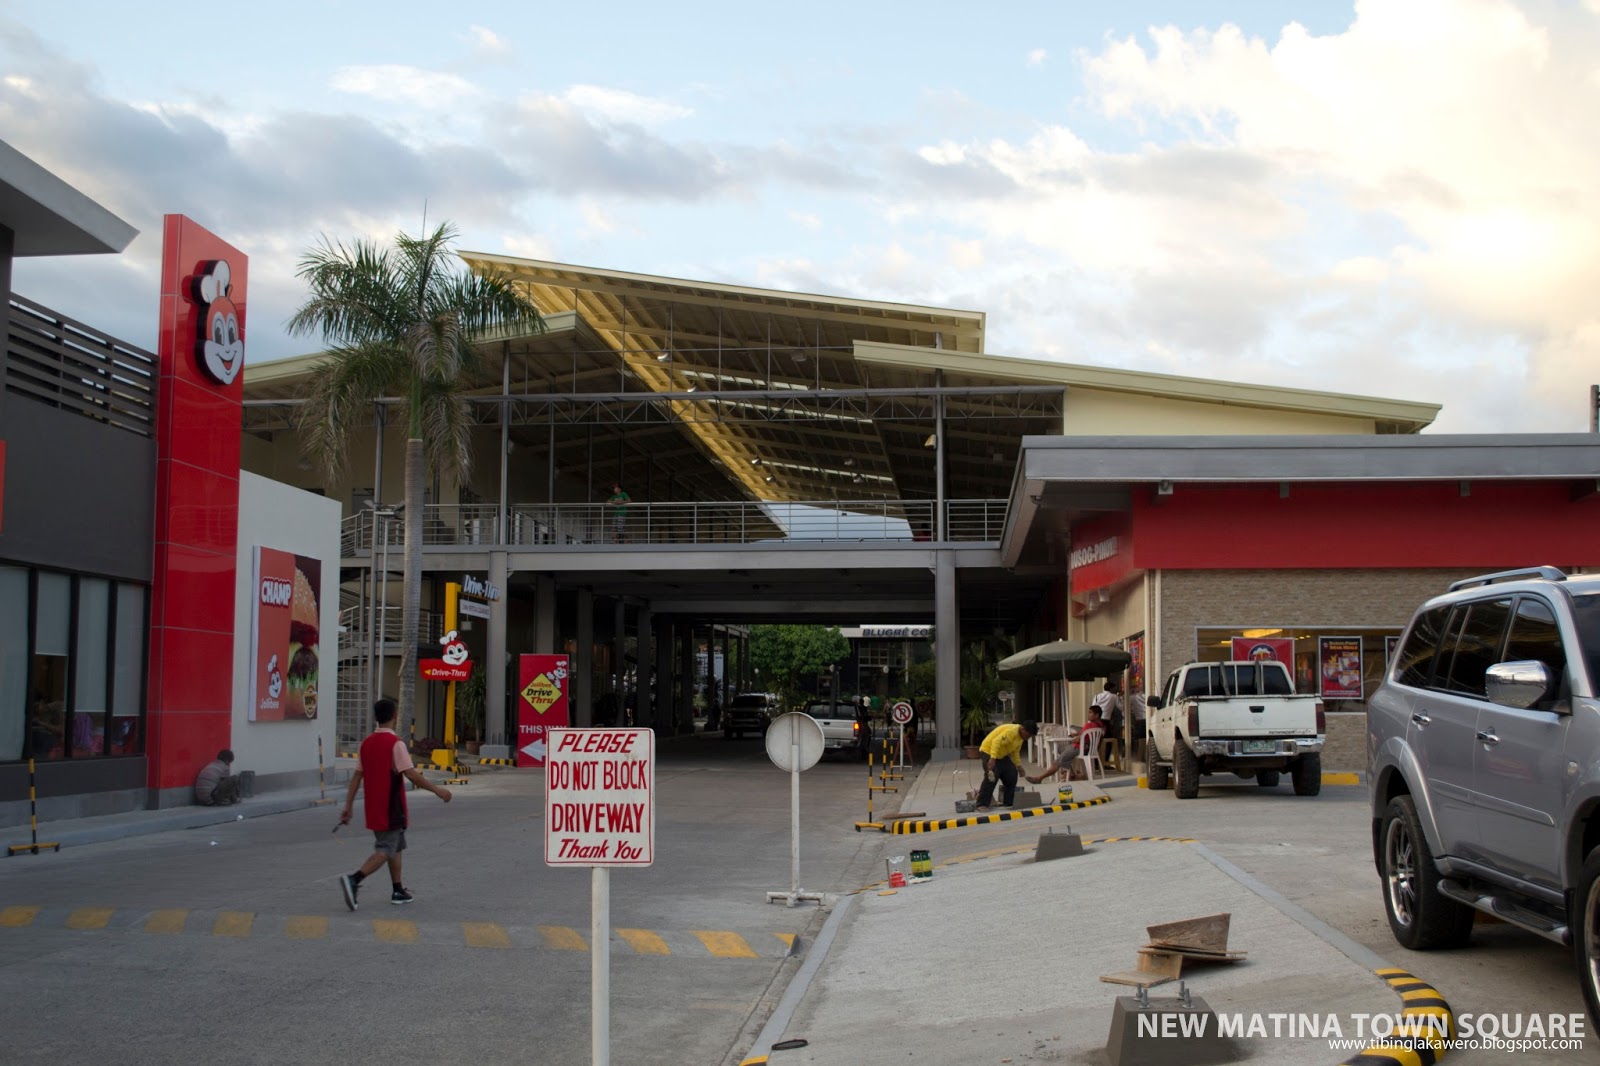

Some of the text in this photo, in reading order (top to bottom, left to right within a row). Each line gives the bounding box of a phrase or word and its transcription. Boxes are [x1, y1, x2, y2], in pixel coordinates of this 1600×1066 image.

[261, 578, 292, 608] CHAMP
[911, 628, 930, 636] CO
[431, 668, 467, 677] Drive-Thru
[526, 688, 553, 696] Drive
[260, 698, 280, 709] Jollibee
[519, 724, 543, 734] THIS
[557, 733, 638, 753] PLEASE
[550, 760, 647, 791] DO NOT BLOCK
[551, 803, 645, 833] DRIVEWAY
[557, 838, 643, 860] Thank You
